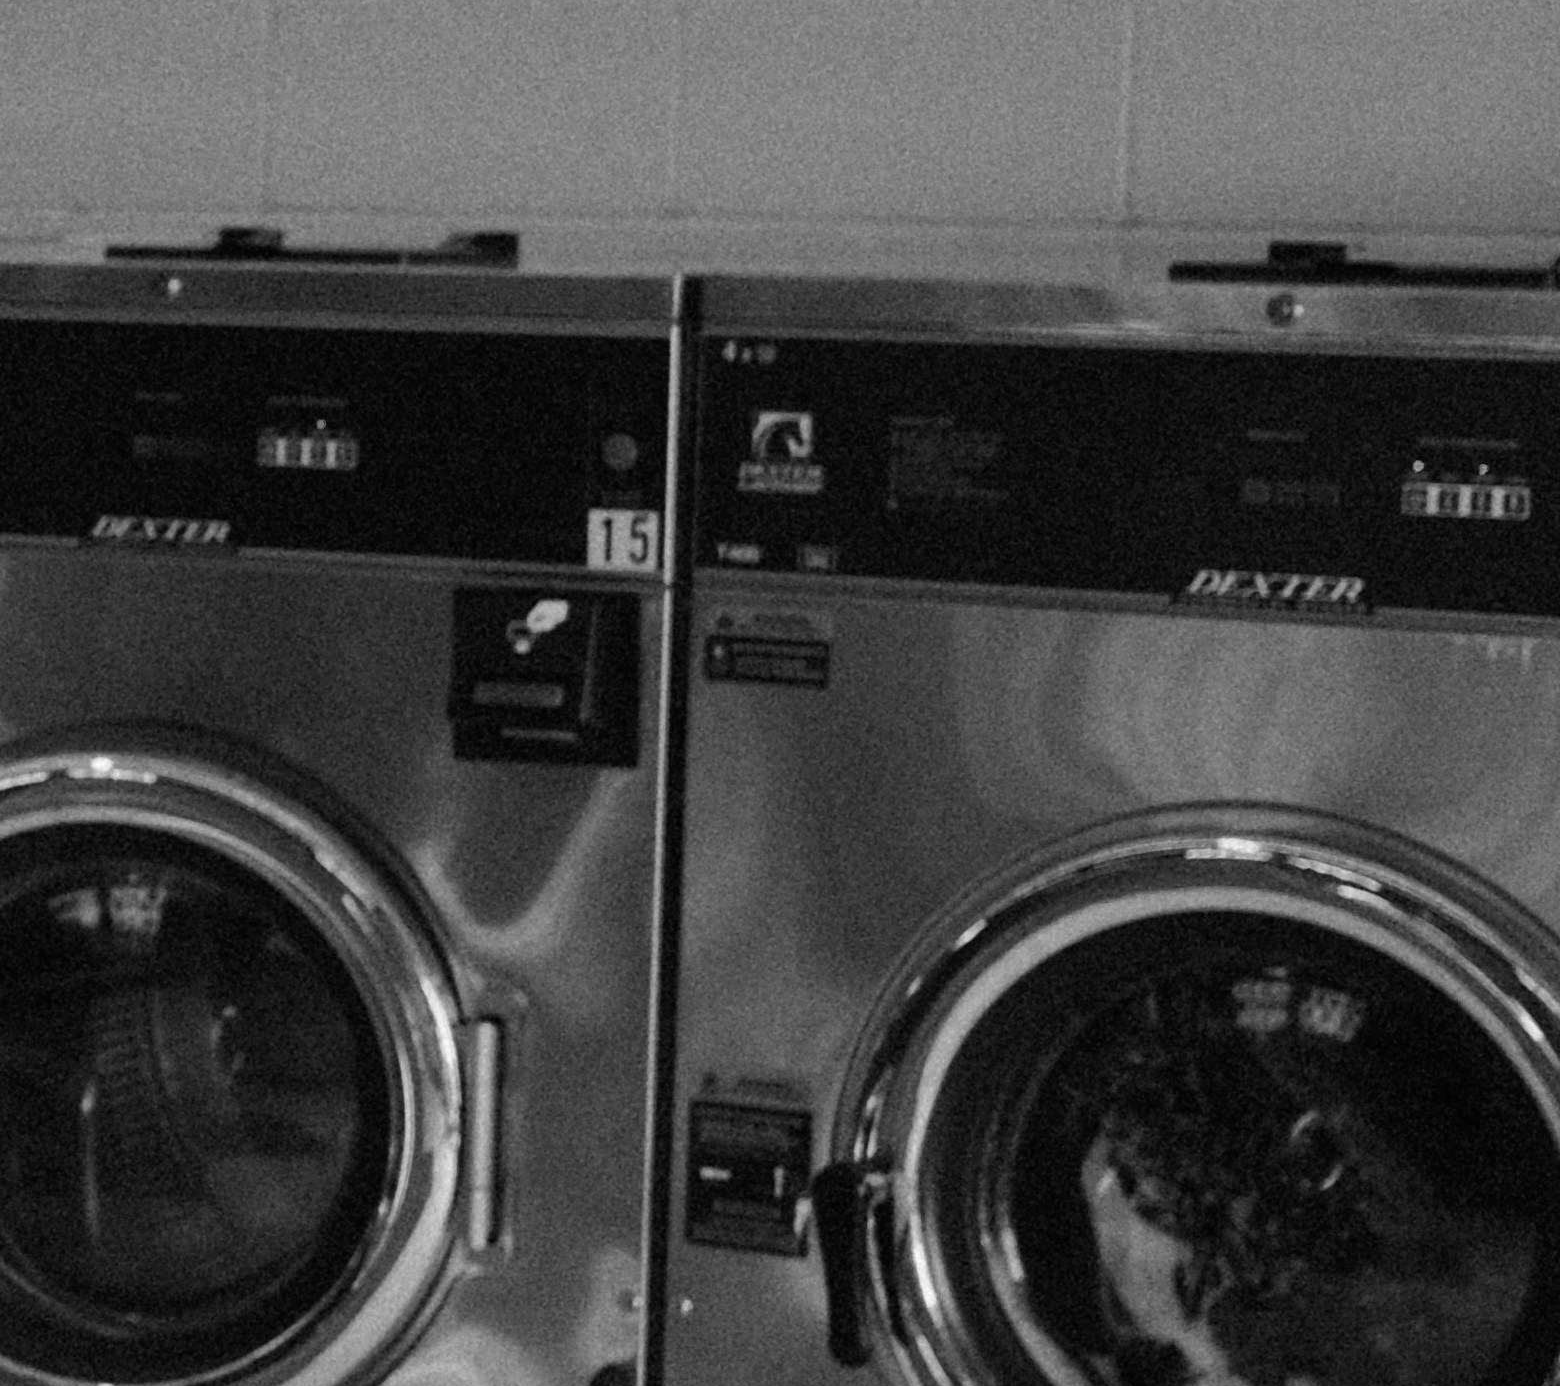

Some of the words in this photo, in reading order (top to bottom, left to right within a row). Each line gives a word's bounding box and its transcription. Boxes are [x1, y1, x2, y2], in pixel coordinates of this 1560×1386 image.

[91, 515, 229, 543] DEXTER
[601, 516, 649, 564] 15
[1188, 569, 1363, 603] DEXTER
